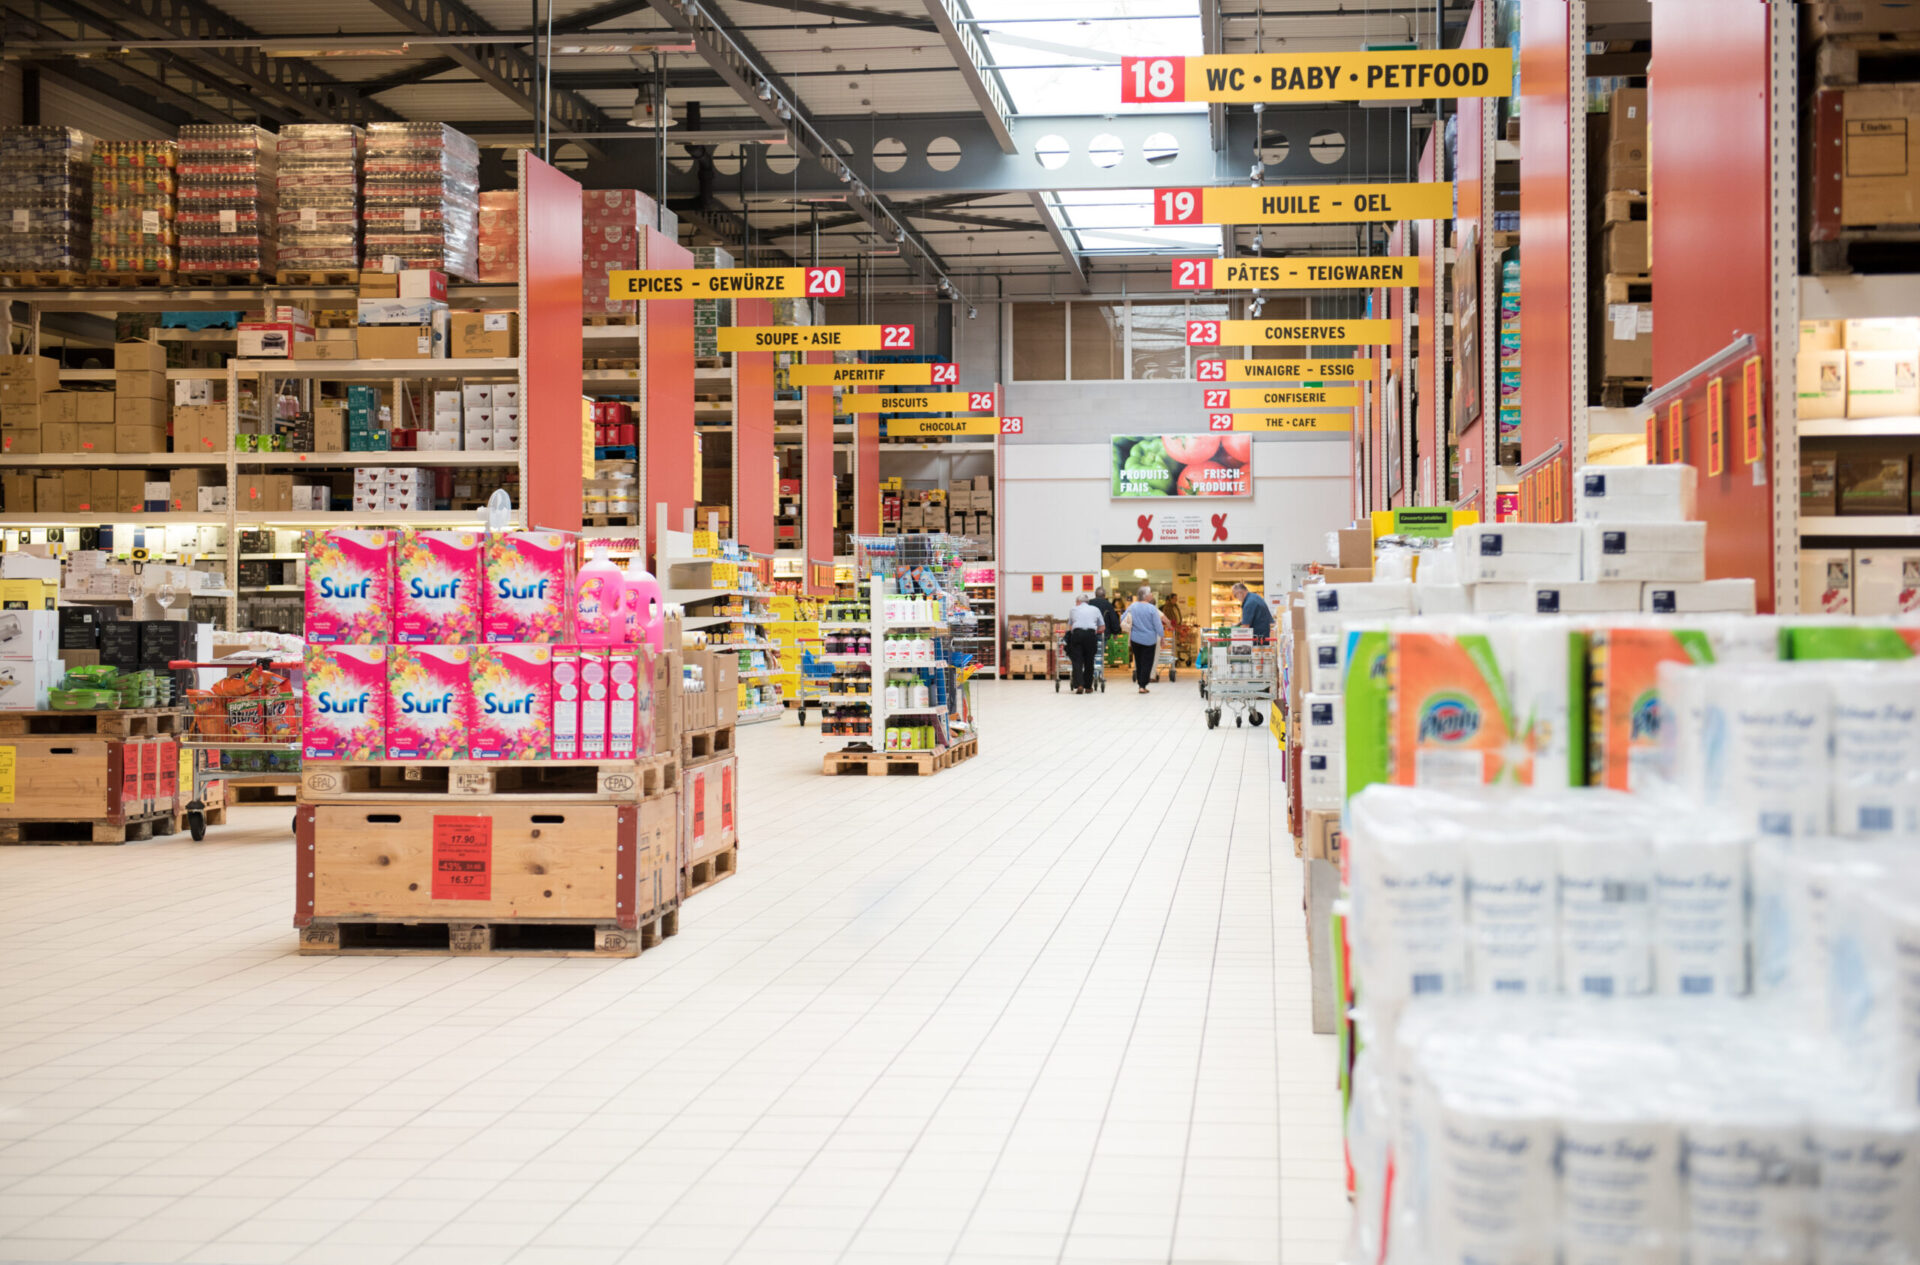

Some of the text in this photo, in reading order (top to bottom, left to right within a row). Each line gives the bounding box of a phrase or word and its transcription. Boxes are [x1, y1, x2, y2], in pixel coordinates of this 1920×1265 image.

[1130, 59, 1175, 98] 18
[1206, 67, 1245, 91] WC
[1271, 65, 1341, 90] BABY
[1367, 62, 1489, 89] PETFOOD
[1161, 191, 1195, 220] 19
[1262, 195, 1321, 215] HUILE
[1354, 194, 1392, 213] OEL
[628, 277, 683, 293] EPICES
[709, 272, 785, 292] GEWÜRZE
[809, 269, 841, 294] 20
[1178, 261, 1206, 286] 21
[1227, 261, 1280, 281] PÂTES
[1307, 264, 1404, 281] TEIGWAREN
[755, 332, 799, 346] SOUPE
[811, 332, 841, 345] ASIE
[884, 326, 911, 347] 22
[1189, 322, 1346, 343] 23 CONSERVES
[833, 365, 957, 383] APERITIF 24
[1199, 361, 1224, 380] 25
[1244, 364, 1301, 376] VINAIGRE
[1320, 364, 1355, 376] ESSIG
[881, 393, 992, 410] BISCUITS 26
[1206, 390, 1326, 407] 27 CONFISERIE
[919, 418, 1021, 433] CHOCOLAT 28
[1212, 414, 1231, 429] 29
[1265, 418, 1284, 427] THE
[1292, 418, 1317, 427] CAFE
[1120, 469, 1169, 480] PRODUITS
[1204, 468, 1245, 480] FRISCH-
[1120, 482, 1150, 493] FRAIS
[1193, 481, 1246, 493] PRODUKTE
[320, 576, 372, 599] Surf
[410, 576, 462, 599] Surf
[498, 577, 549, 600] Surf
[578, 603, 600, 615] Surf
[317, 691, 370, 714] Surf
[401, 691, 454, 714] Surf
[484, 692, 536, 715] Surf
[311, 777, 332, 789] EPAL
[607, 778, 627, 789] EPAL
[605, 938, 622, 950] EUR
